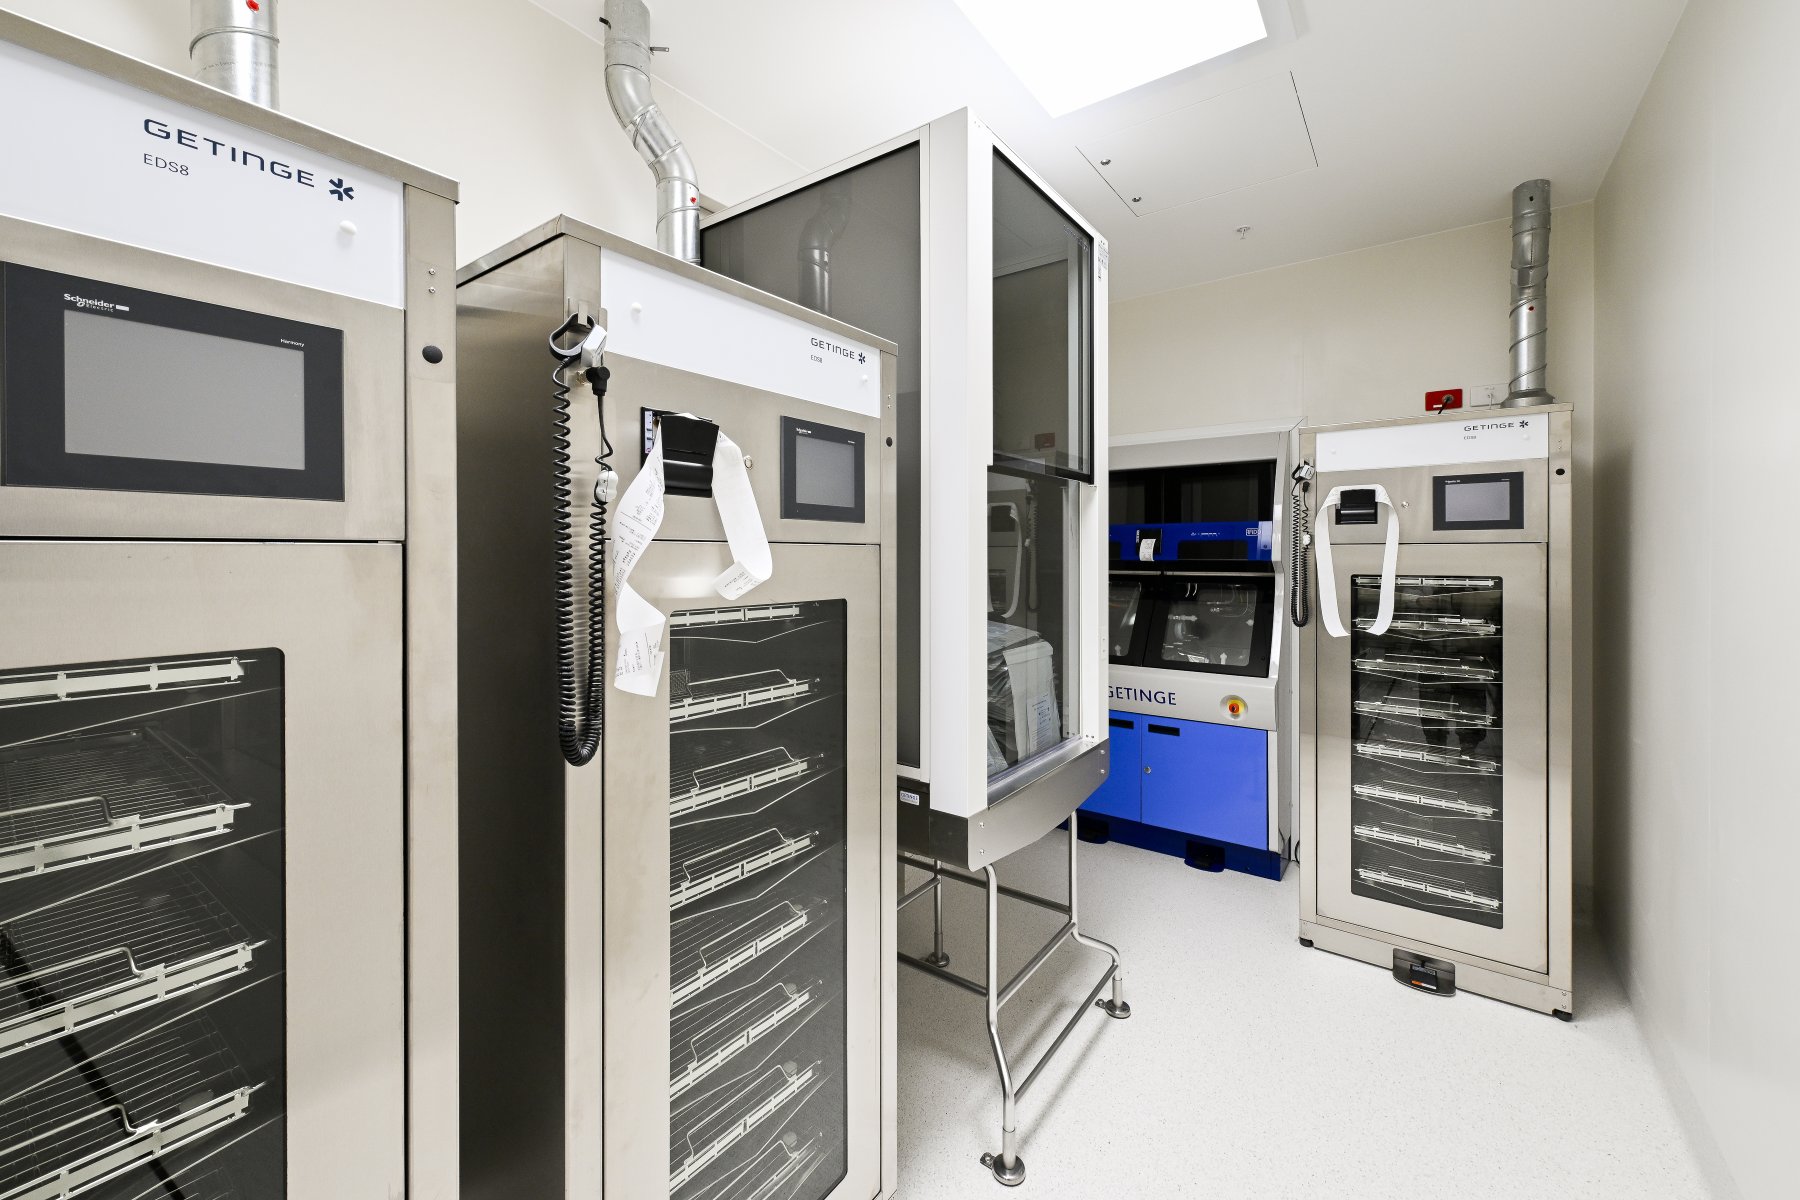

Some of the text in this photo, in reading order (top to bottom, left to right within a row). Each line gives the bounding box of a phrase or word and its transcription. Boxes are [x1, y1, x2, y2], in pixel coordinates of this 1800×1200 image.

[143, 118, 315, 188] GETINGE
[143, 153, 190, 177] EDS8
[63, 293, 115, 309] Schneider
[810, 337, 855, 360] GETINGE
[1463, 422, 1515, 432] GETINGE
